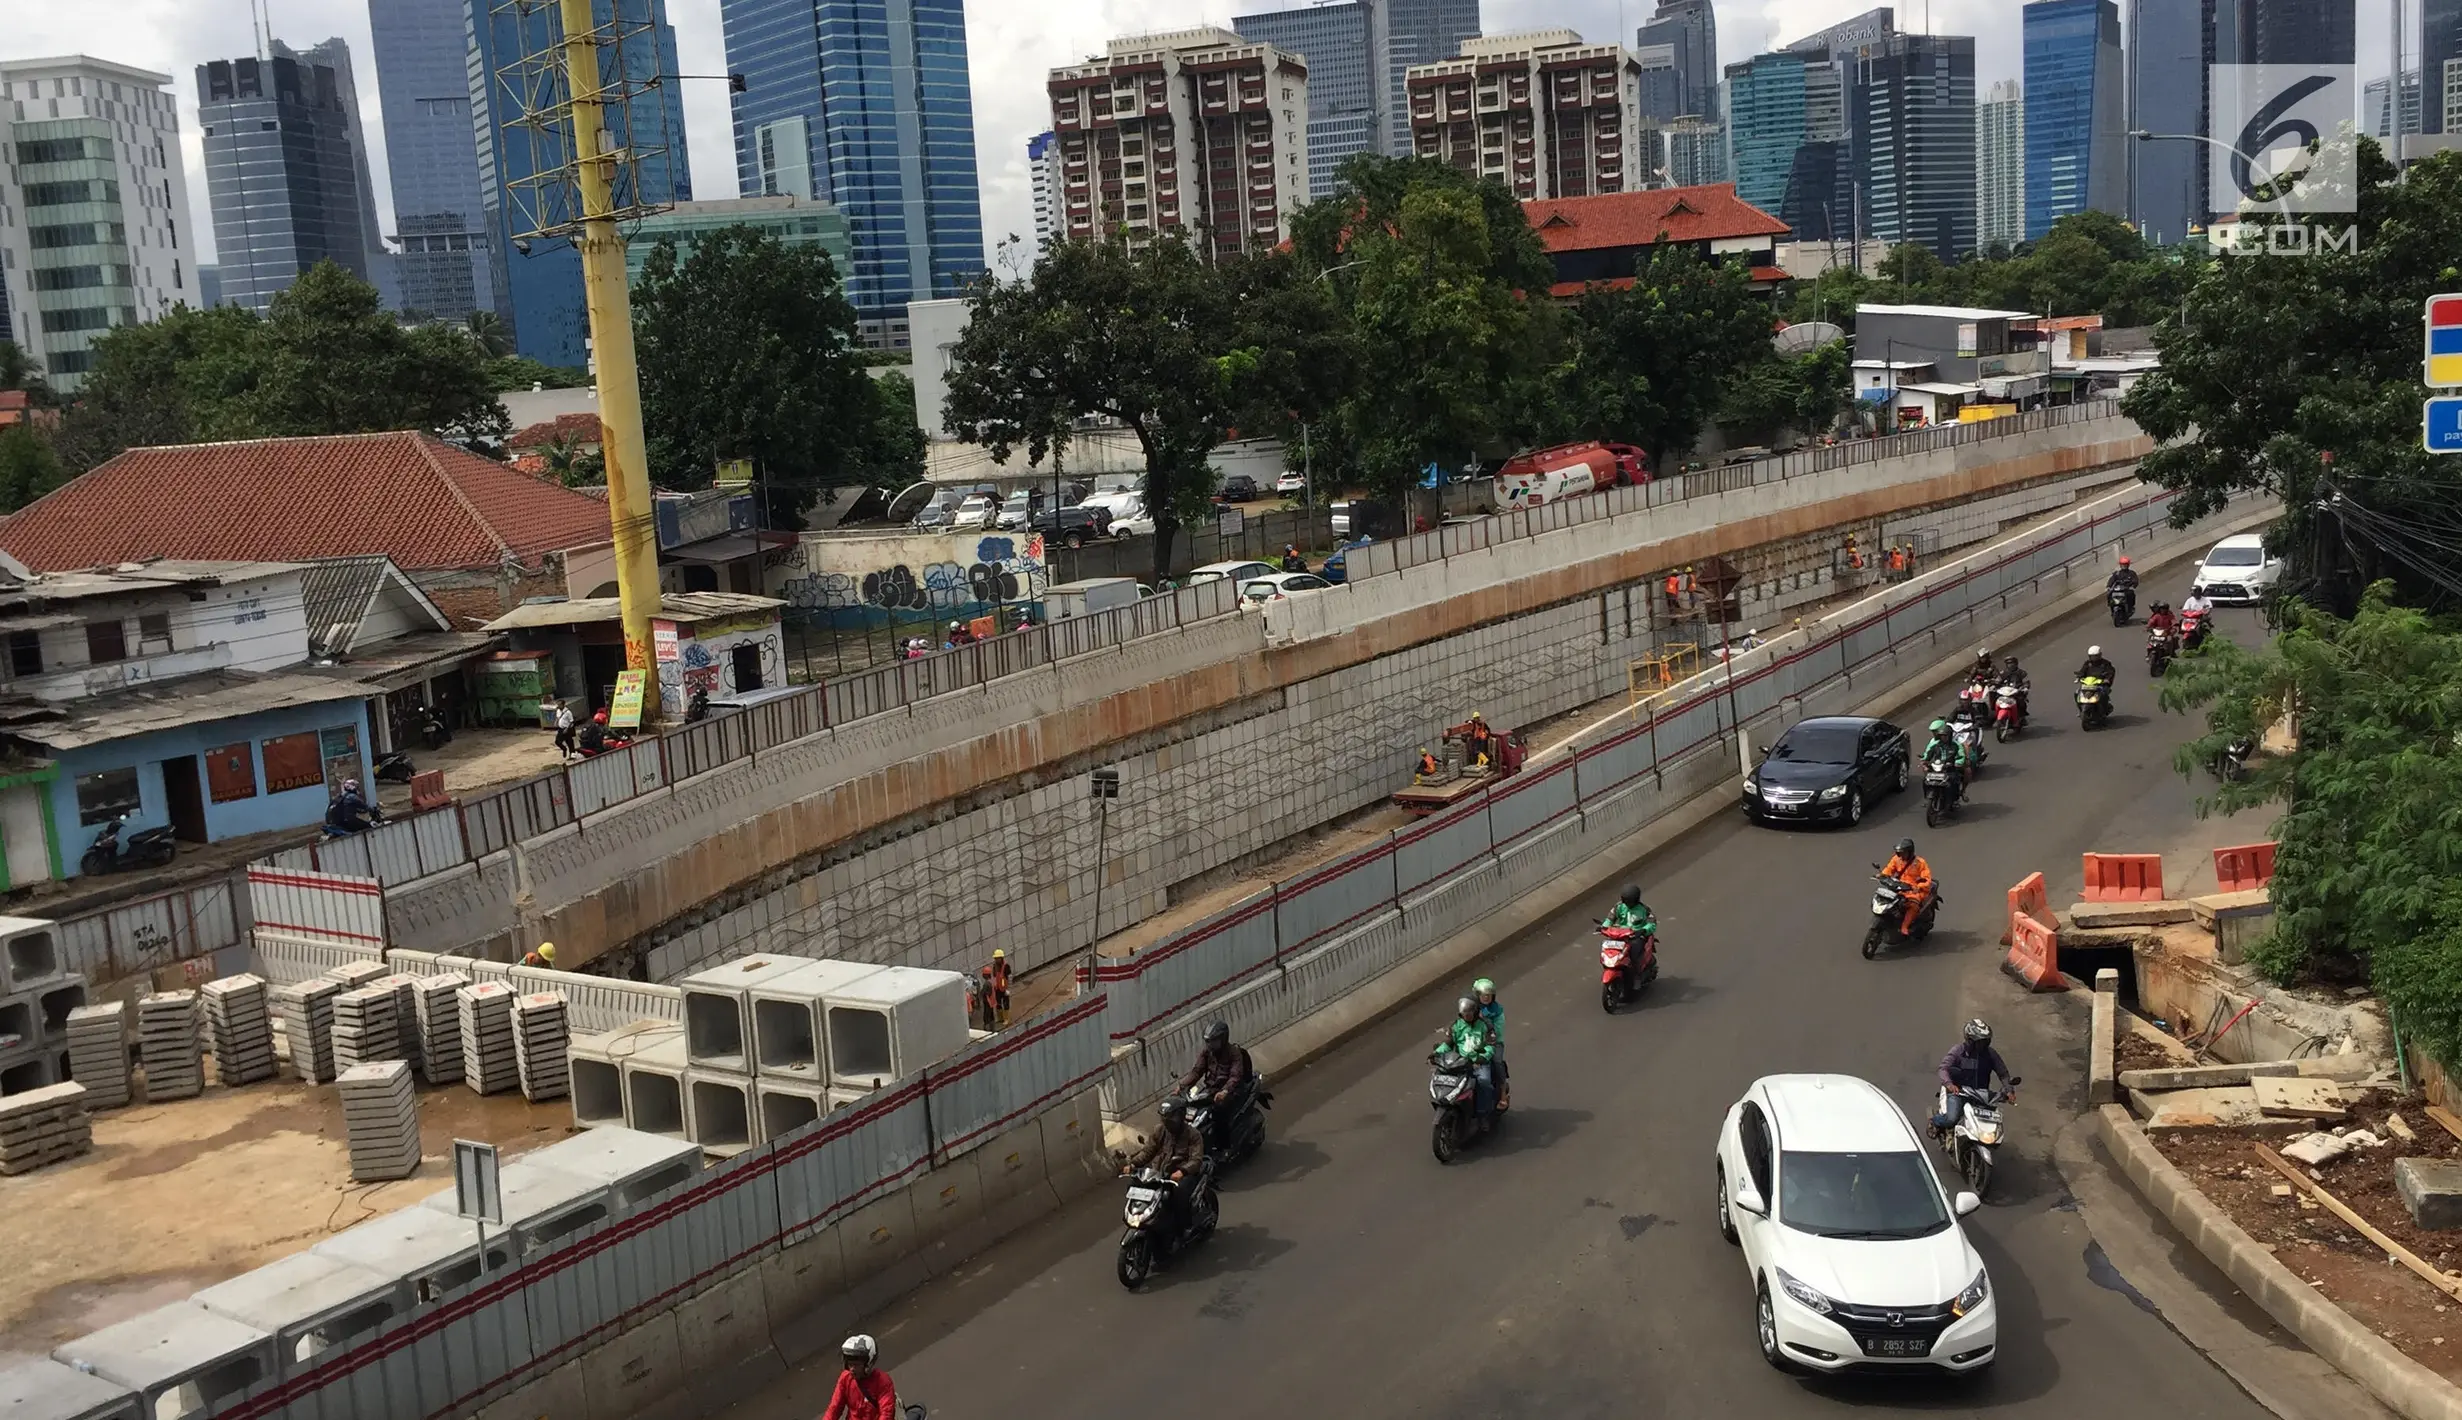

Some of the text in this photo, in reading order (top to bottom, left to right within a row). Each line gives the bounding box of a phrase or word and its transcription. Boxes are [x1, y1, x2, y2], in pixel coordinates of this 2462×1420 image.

[2444, 432, 2462, 443] pa
[267, 773, 322, 792] PADANG
[1867, 1340, 1875, 1350] B
[1909, 1340, 1926, 1350] SZF
